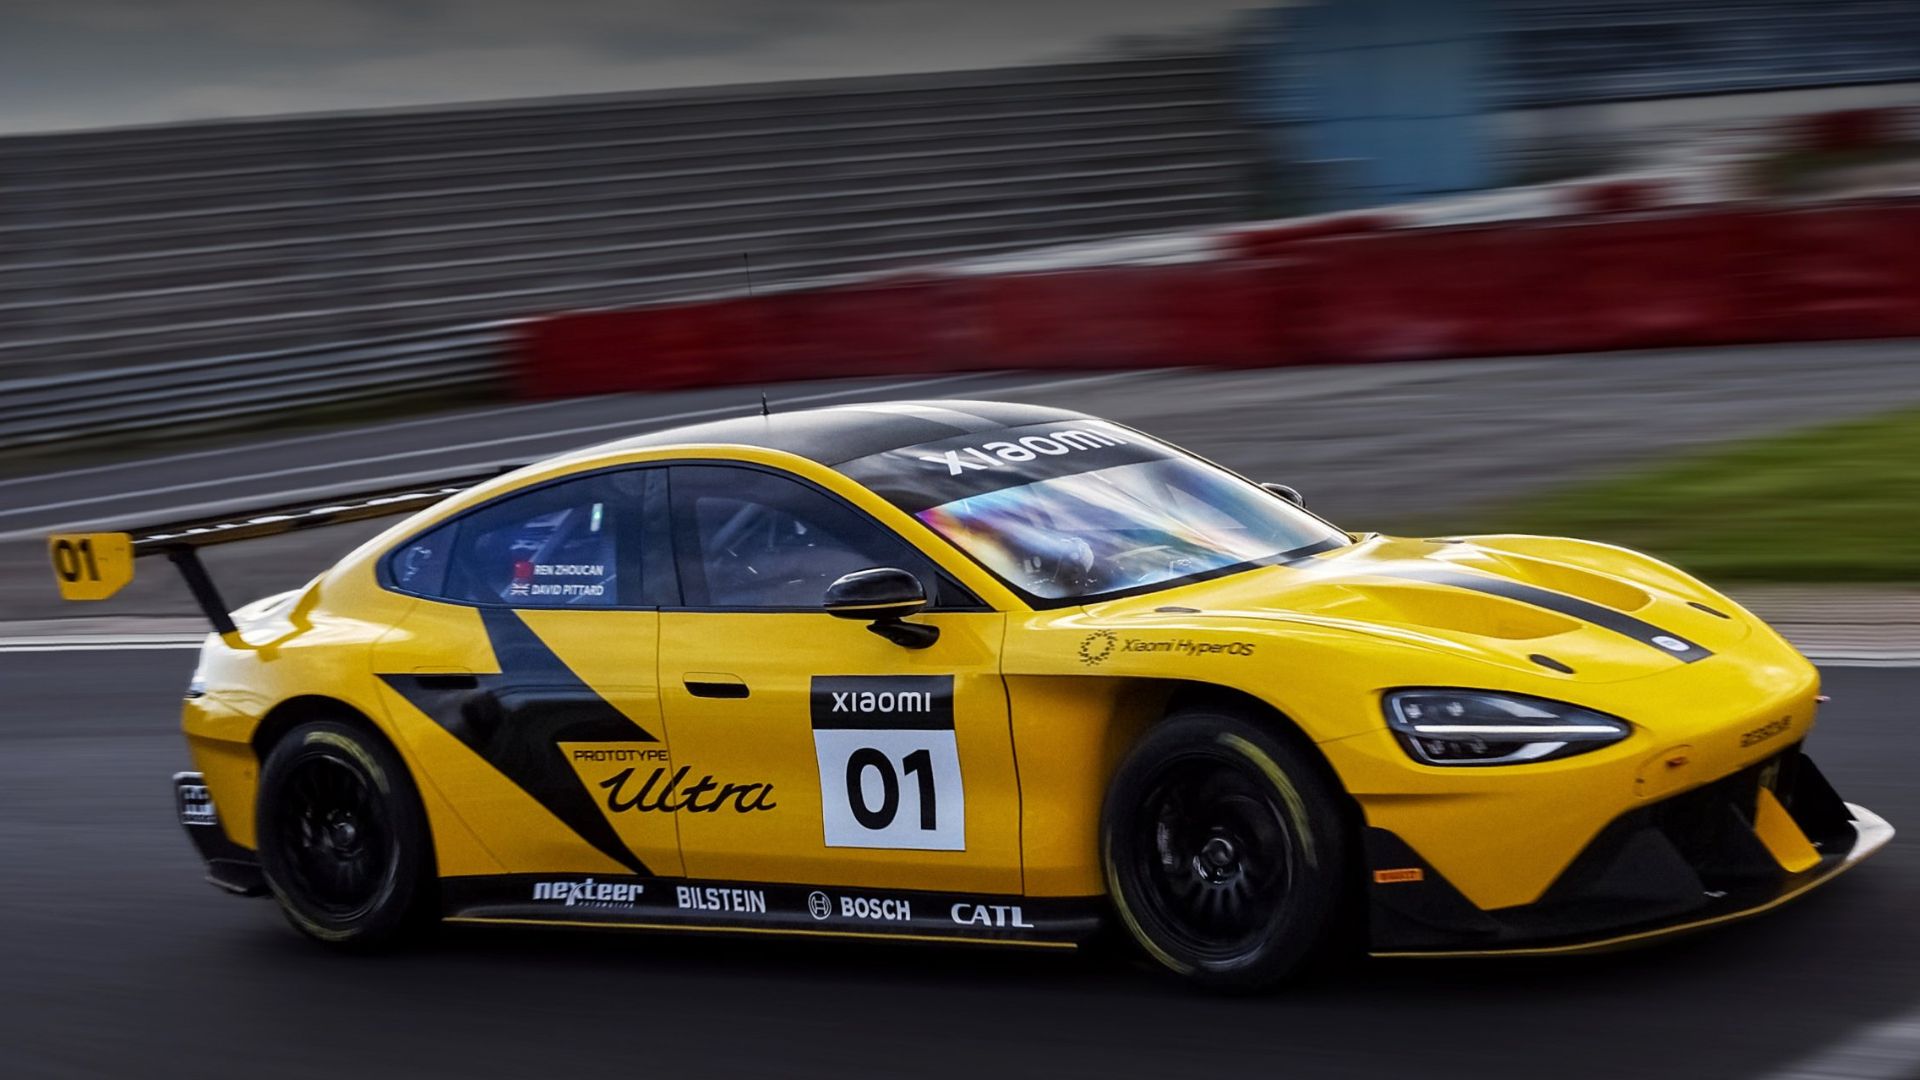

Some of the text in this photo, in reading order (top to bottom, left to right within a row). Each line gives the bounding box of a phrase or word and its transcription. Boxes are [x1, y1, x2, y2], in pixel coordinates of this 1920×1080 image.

[53, 539, 101, 582] 01
[534, 565, 605, 576] REN ZHOUCAN
[531, 584, 605, 596] DAVID PITTARD
[1121, 638, 1256, 656] Xiaomi HyperOS
[573, 750, 669, 761] PROTOTYPE
[598, 765, 777, 813] Ultra
[846, 747, 937, 831] 01
[532, 878, 644, 906] nexteer
[676, 885, 766, 914] BILSTEIN
[840, 896, 911, 921] BOSCH
[951, 903, 1034, 928] CATL
